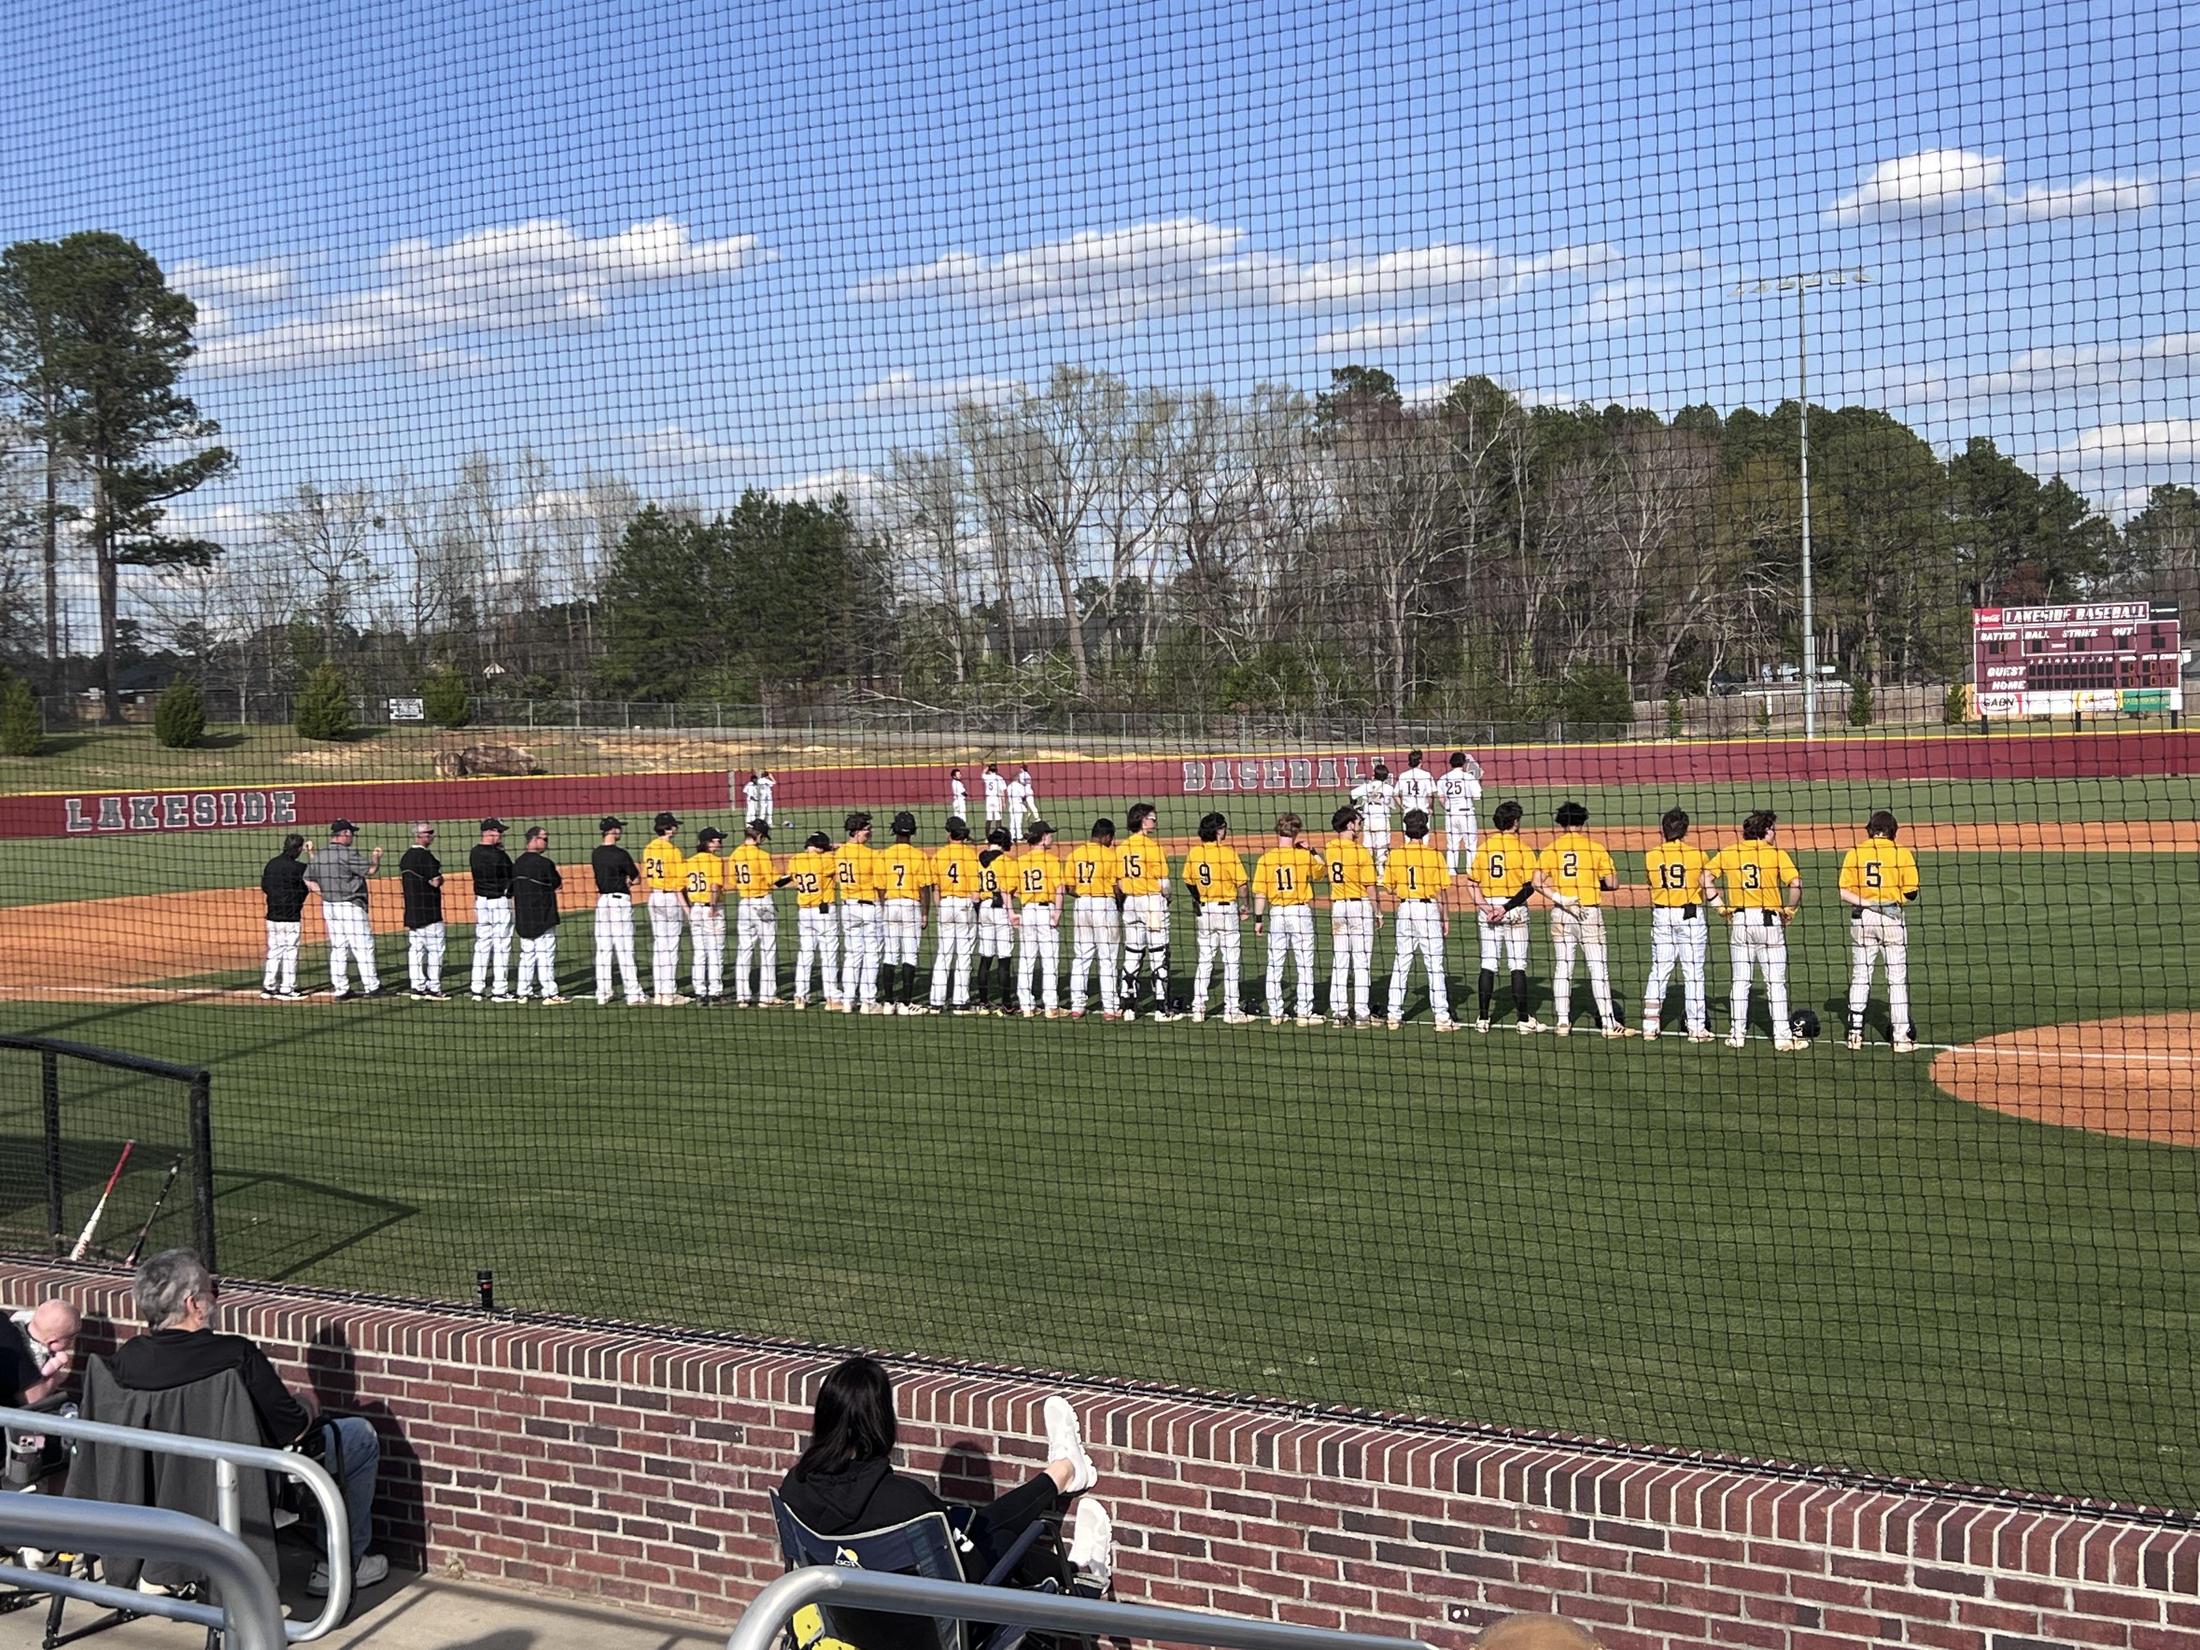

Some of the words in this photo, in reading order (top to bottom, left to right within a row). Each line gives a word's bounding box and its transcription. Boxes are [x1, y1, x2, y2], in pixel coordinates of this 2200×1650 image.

[2005, 608, 2071, 623] LAKESIDE
[2075, 604, 2146, 620] BASEBALL
[1980, 631, 2017, 641] BATTER
[2024, 630, 2050, 640] BALL
[2062, 628, 2099, 638] STRIKE
[2112, 627, 2133, 636] OUT
[1987, 666, 2027, 677] GUEST
[1992, 680, 2027, 690] HOME
[1405, 780, 1420, 796] 14
[1445, 780, 1462, 796] 25
[64, 790, 297, 832] LAKESIDE
[645, 857, 665, 880] 24
[734, 863, 751, 885] 16
[892, 864, 906, 887] 7
[946, 862, 959, 884] 4
[1077, 860, 1096, 884] 17
[1123, 854, 1142, 878] 15
[1198, 862, 1212, 886] 9
[1331, 861, 1345, 884] 8
[1488, 853, 1505, 879] 6
[1562, 851, 1578, 878] 2
[1658, 862, 1687, 890] 19
[1743, 862, 1760, 890] 3
[1864, 860, 1882, 888] 5
[977, 870, 998, 893] 18
[1022, 868, 1043, 892] 12
[1275, 866, 1294, 891] 11
[1407, 865, 1417, 890] 1
